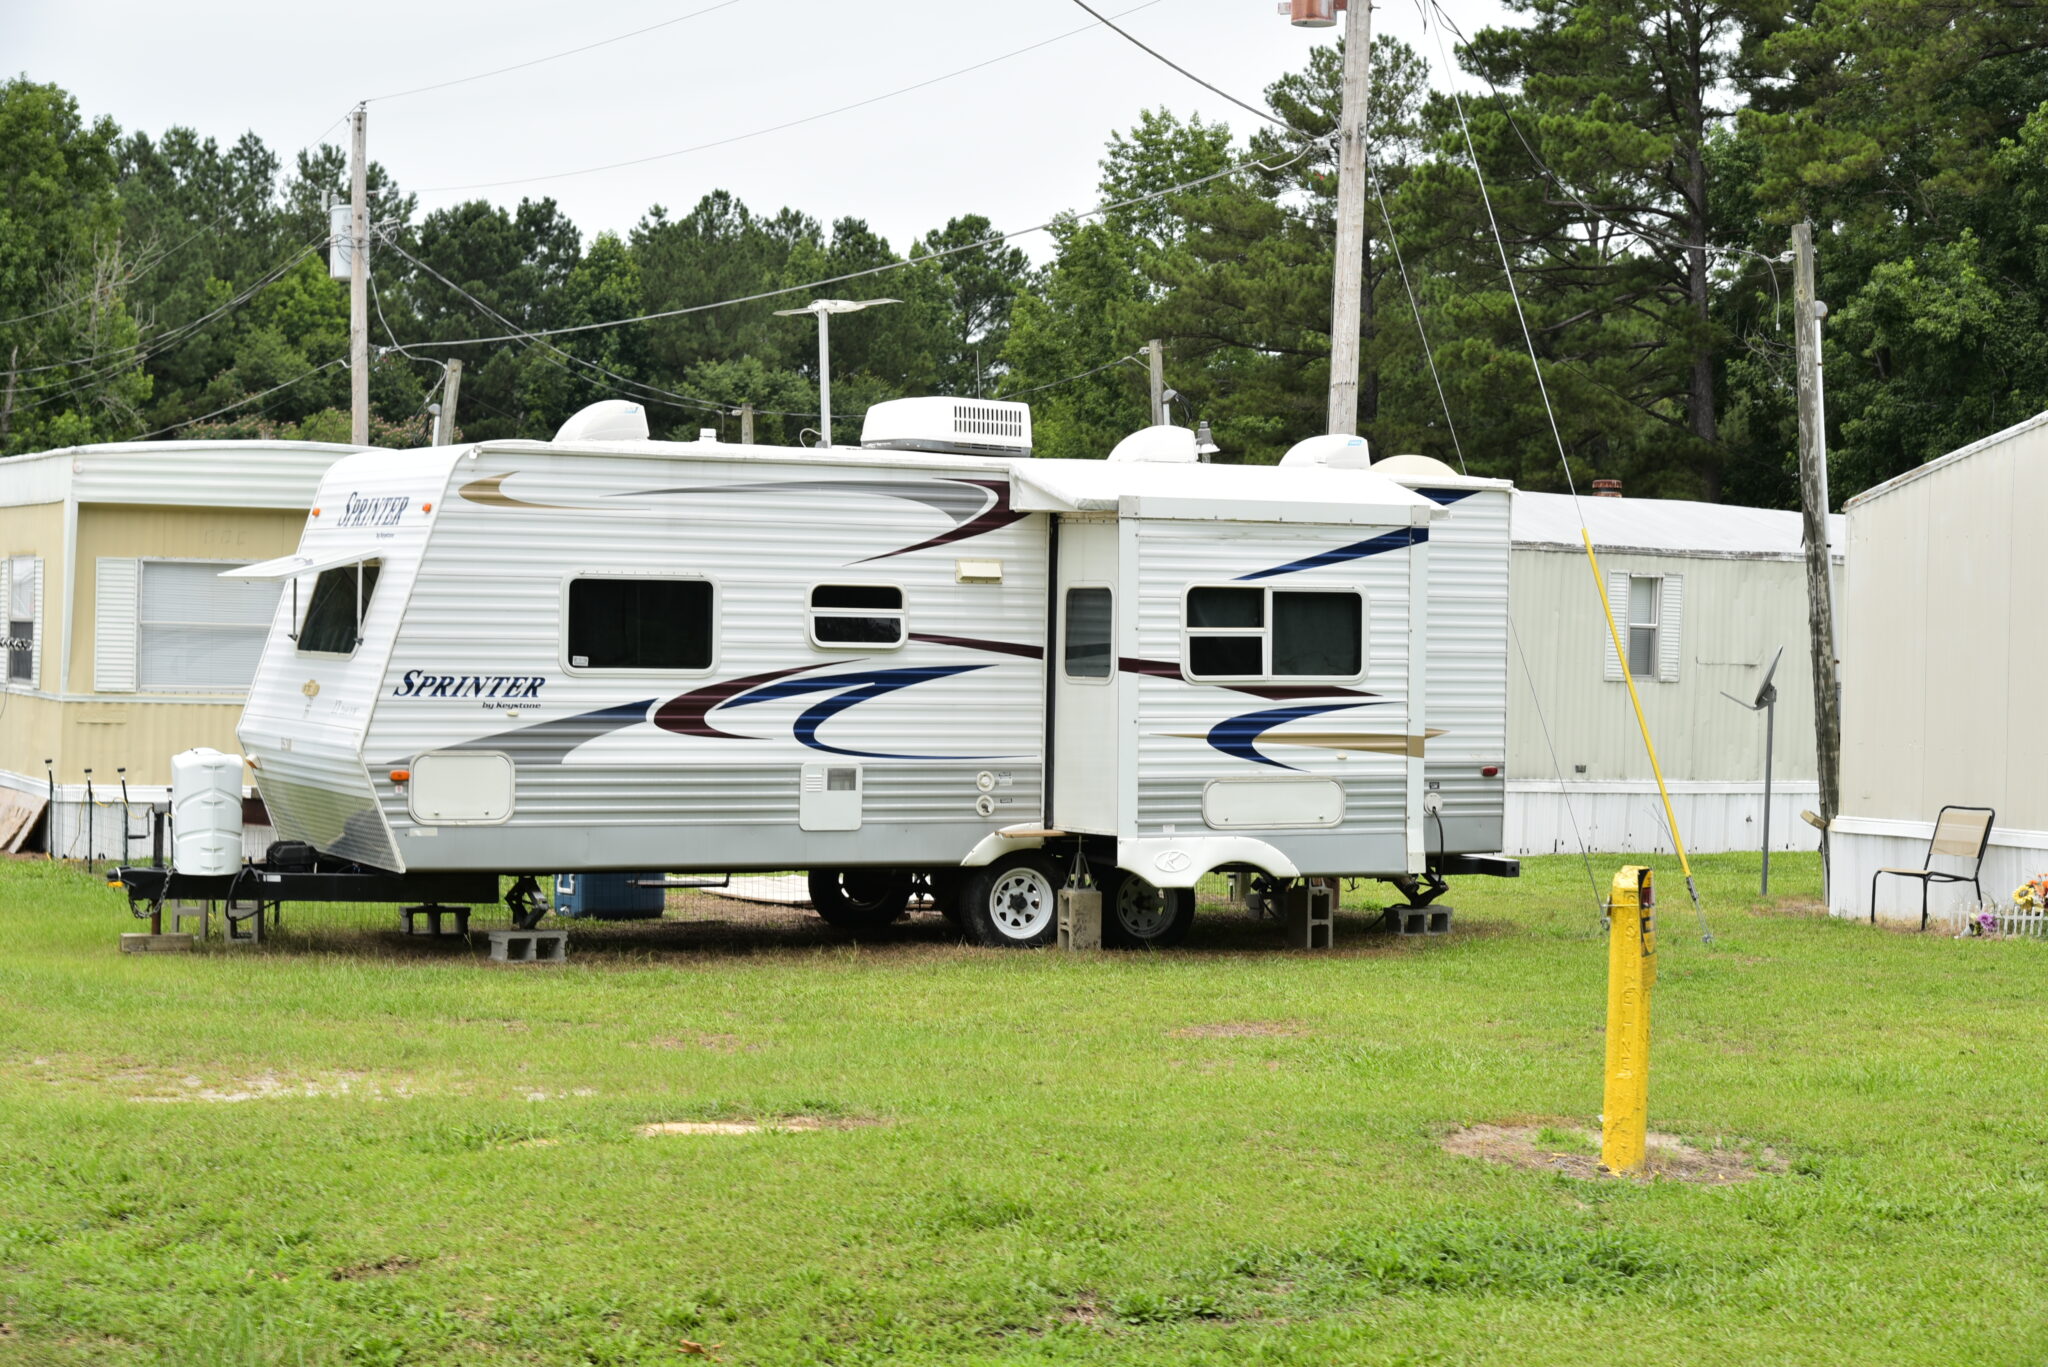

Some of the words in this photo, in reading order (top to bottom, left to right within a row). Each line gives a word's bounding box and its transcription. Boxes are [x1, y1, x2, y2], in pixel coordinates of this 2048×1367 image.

[337, 491, 410, 527] SPRINTER
[393, 669, 546, 698] SPRINTER
[482, 701, 494, 709] by
[496, 701, 541, 710] Keystone
